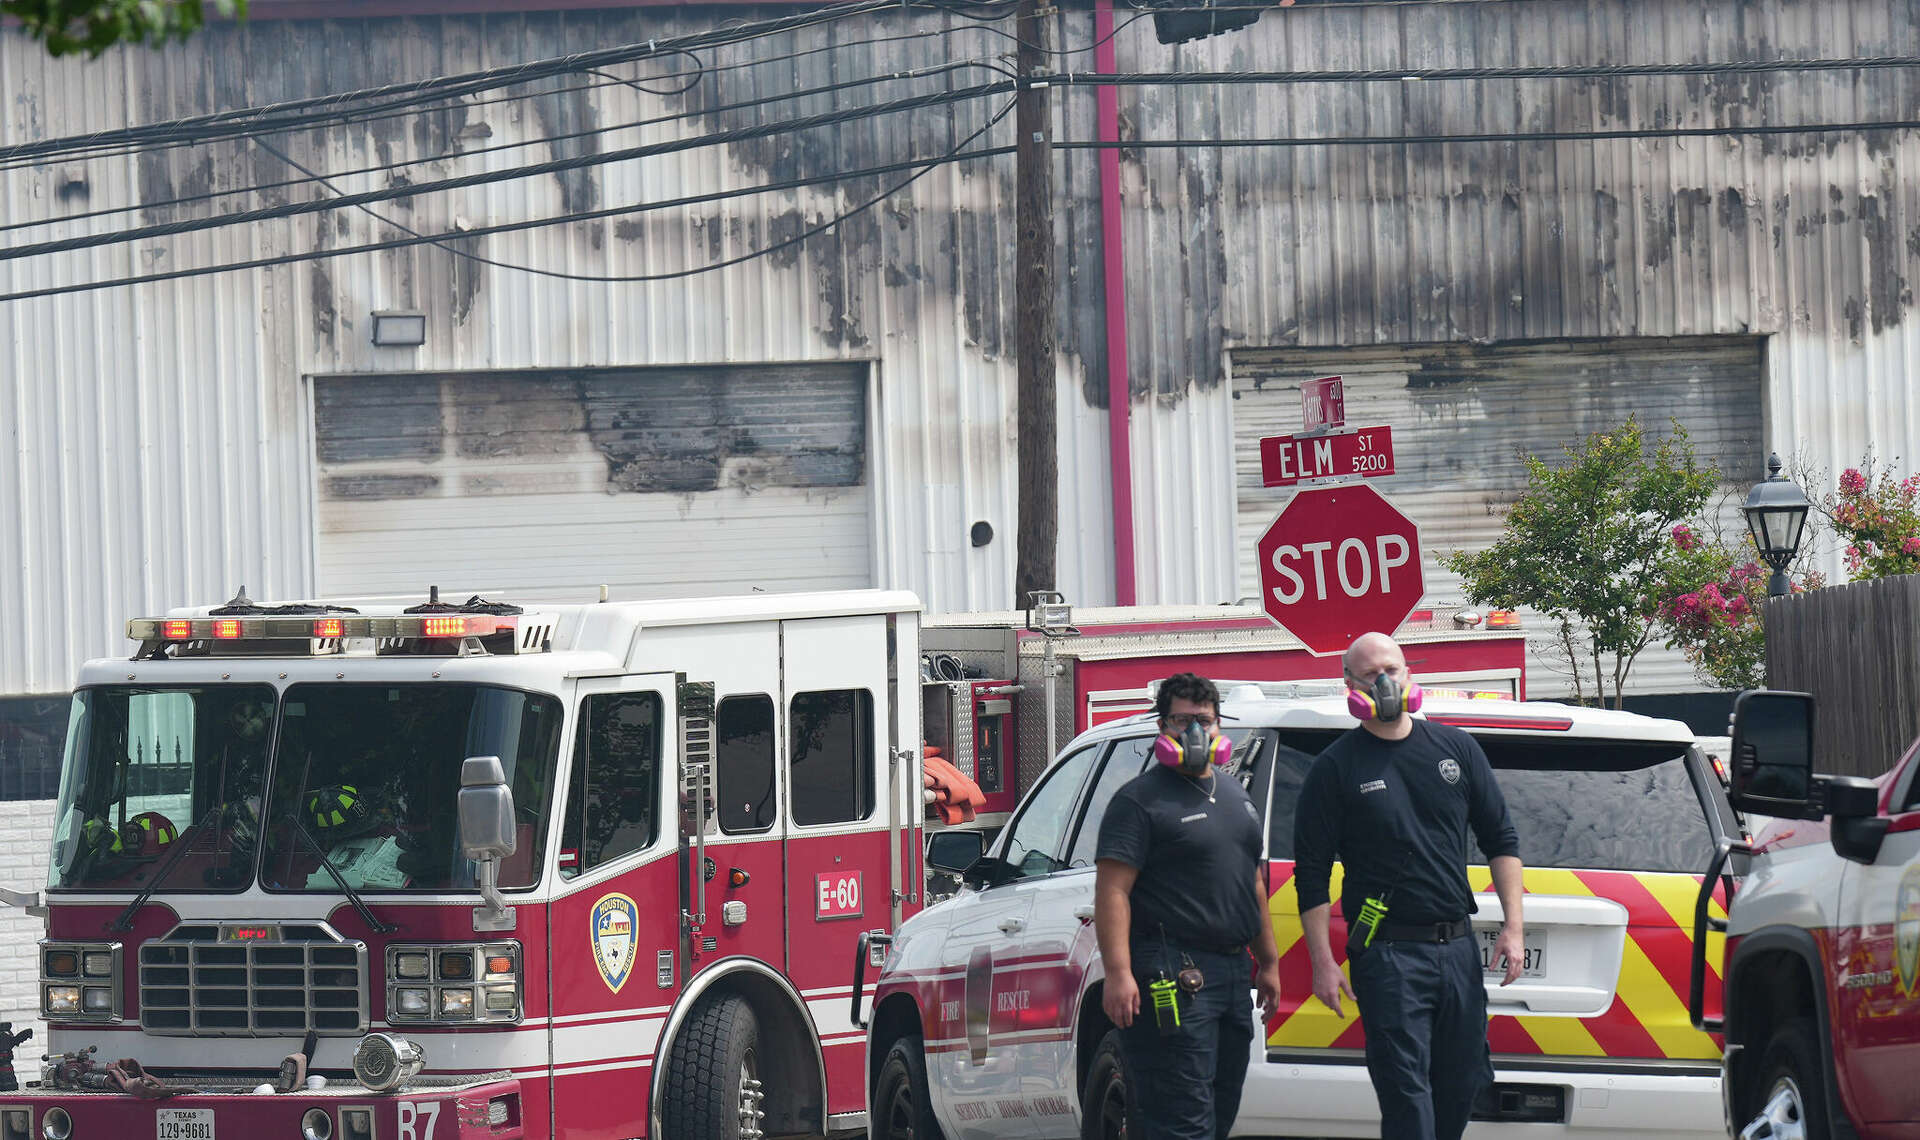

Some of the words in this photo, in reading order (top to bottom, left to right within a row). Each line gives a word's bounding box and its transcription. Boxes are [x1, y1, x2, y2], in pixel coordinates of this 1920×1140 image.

[1280, 440, 1333, 478] ELM
[1359, 435, 1373, 451] ST
[1352, 454, 1387, 472] 5200
[1272, 534, 1410, 605] STOP
[599, 899, 629, 915] HOUSTON
[820, 878, 858, 909] E-60
[941, 1001, 960, 1021] FIRE
[998, 990, 1030, 1012] RESCUE
